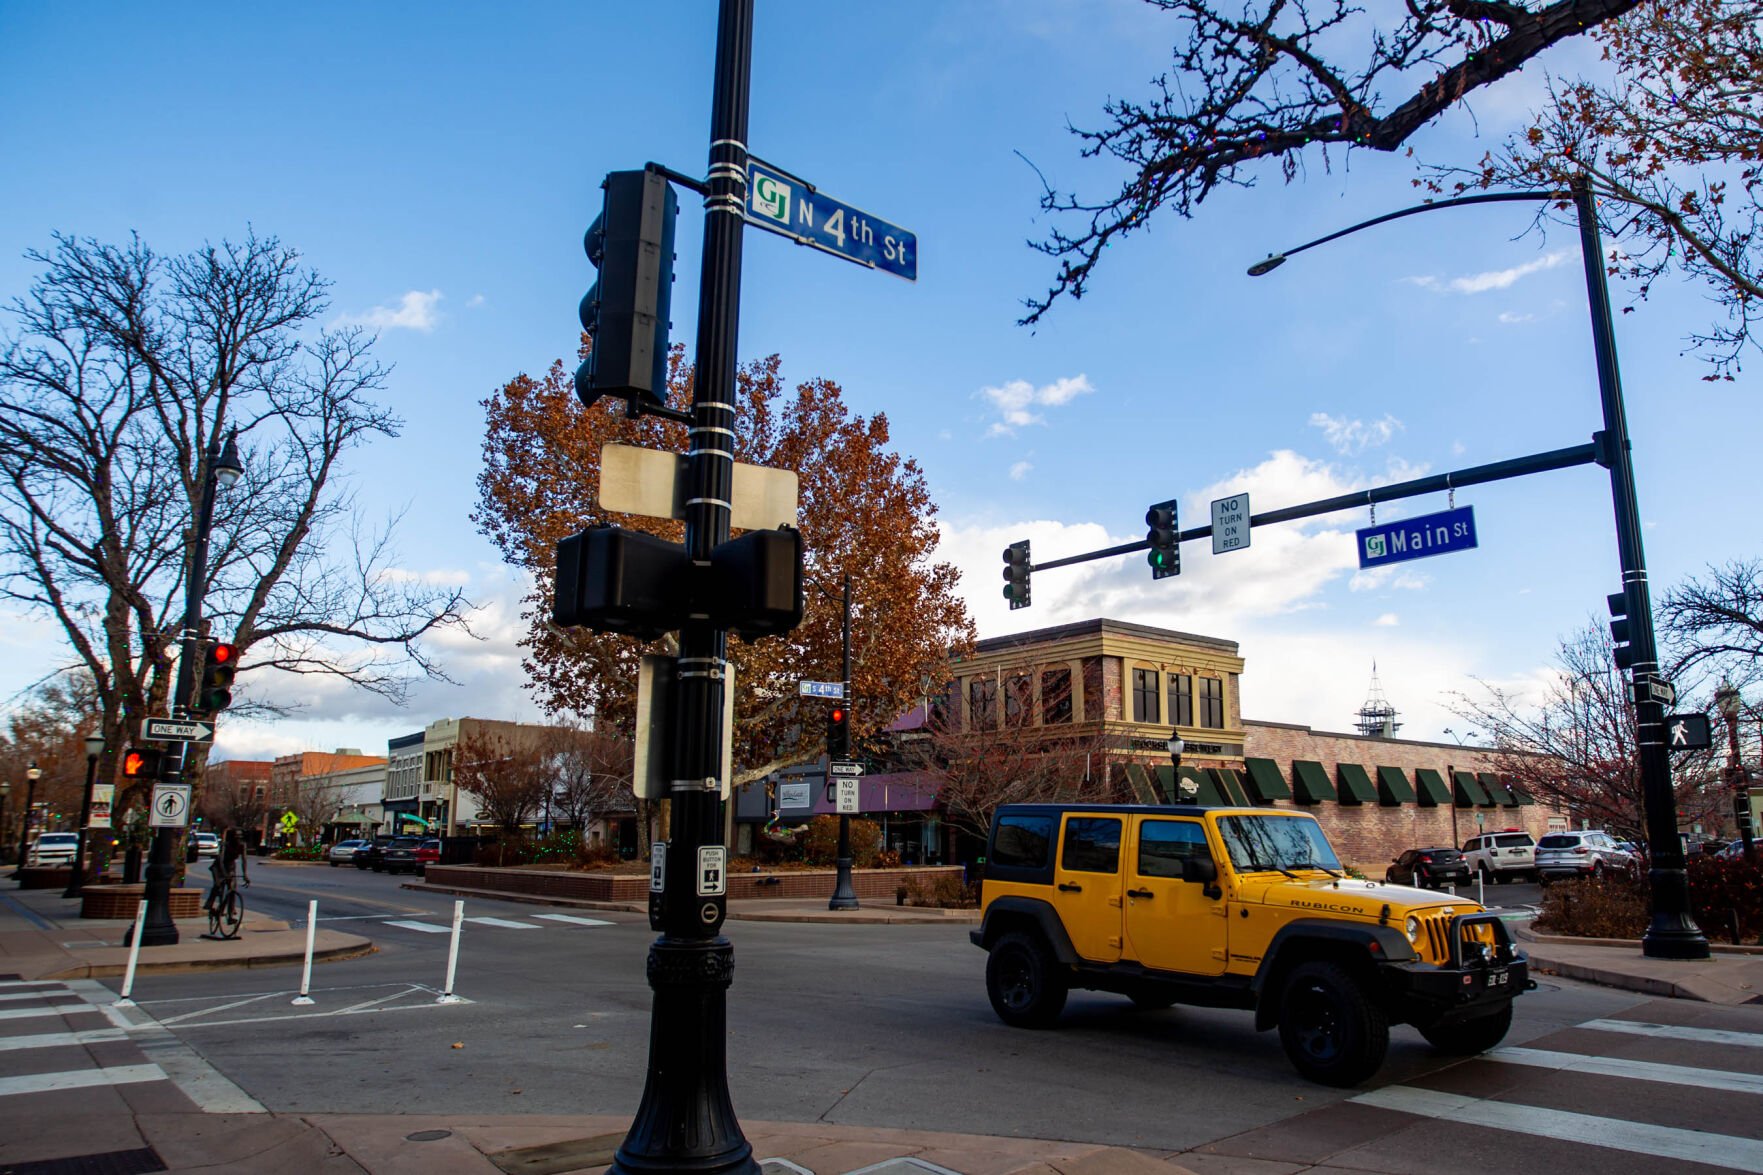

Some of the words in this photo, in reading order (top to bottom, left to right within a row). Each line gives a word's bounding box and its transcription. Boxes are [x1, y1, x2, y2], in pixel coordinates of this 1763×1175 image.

[799, 199, 814, 228] N
[823, 208, 873, 247] 4th
[884, 236, 906, 265] St
[1221, 499, 1239, 514] NO
[1219, 513, 1243, 526] TURN
[1224, 526, 1237, 537] ON
[1391, 523, 1450, 554] Main
[1453, 521, 1469, 537] St
[1223, 537, 1240, 549] RED
[812, 685, 817, 693] S
[819, 684, 832, 695] 4th
[154, 724, 173, 734] ONE
[176, 726, 196, 735] WAY
[1290, 900, 1364, 913] RUBICON
